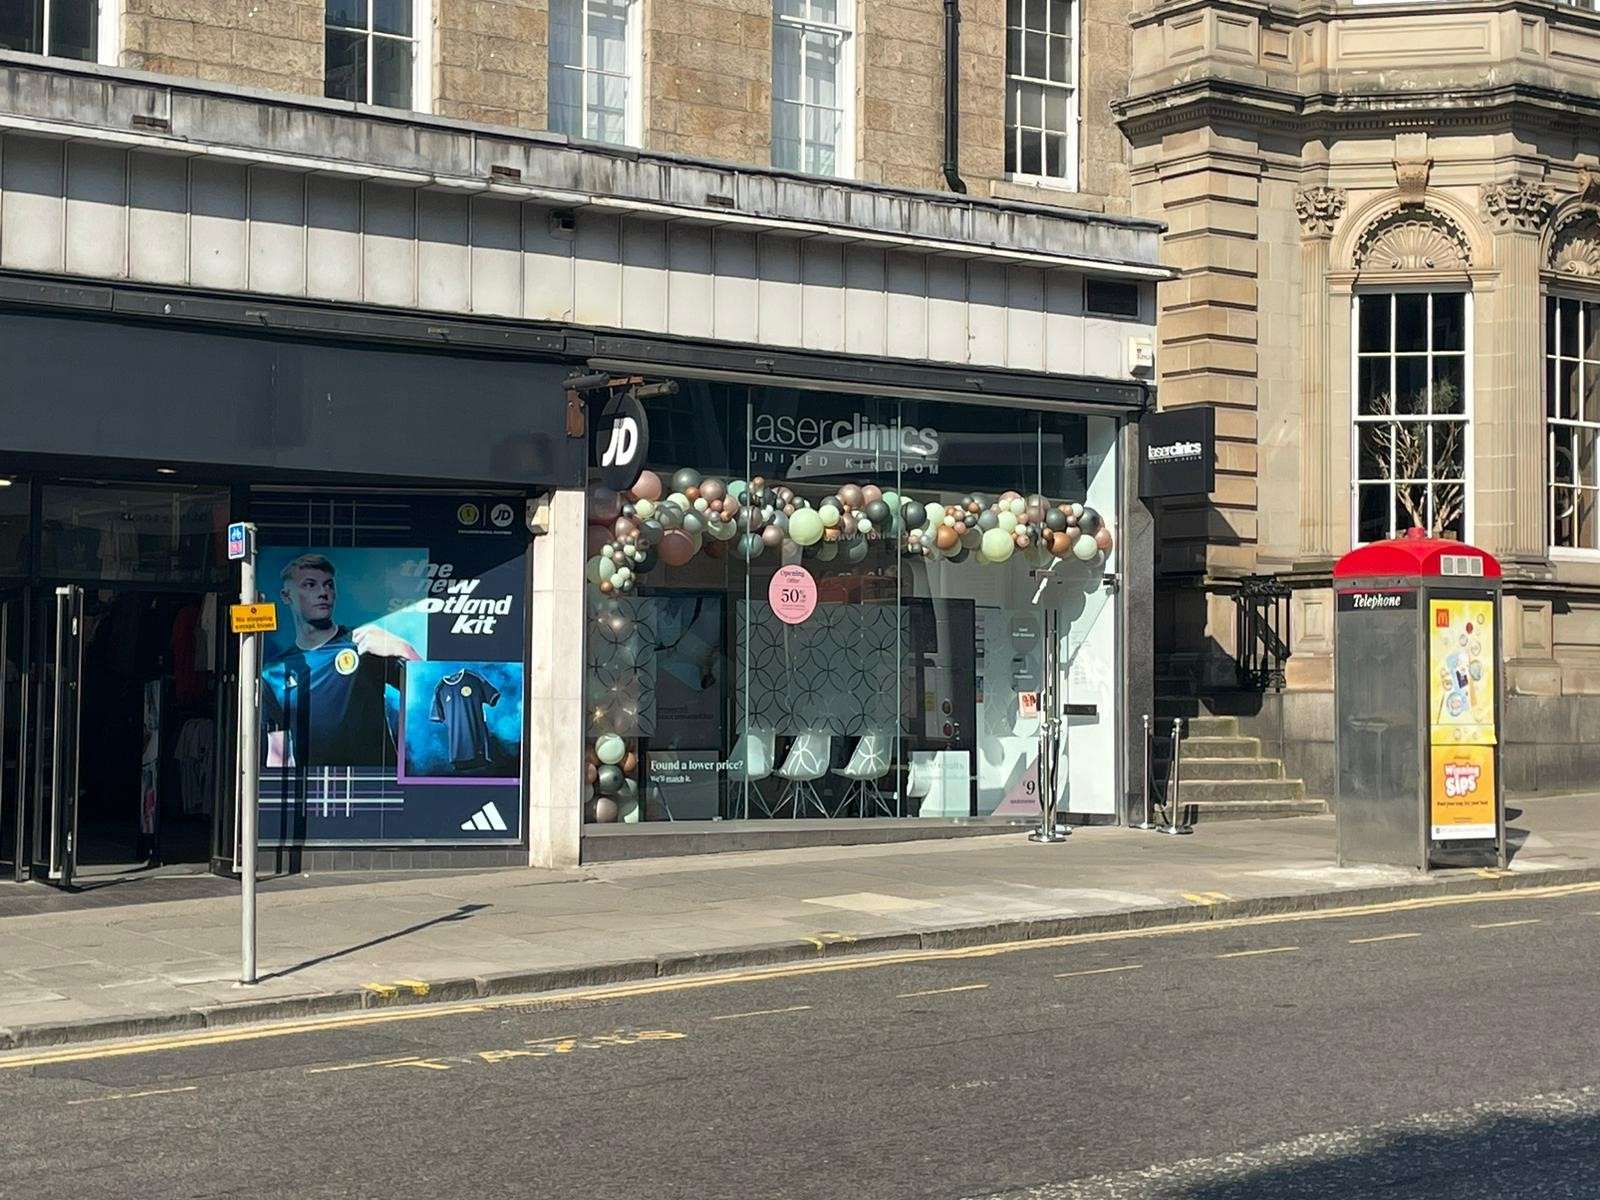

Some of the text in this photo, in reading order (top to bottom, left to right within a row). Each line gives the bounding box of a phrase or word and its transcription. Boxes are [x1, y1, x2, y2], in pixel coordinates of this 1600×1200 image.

[602, 417, 638, 466] JD
[750, 413, 939, 455] laserclinics
[751, 451, 939, 475] UNITED KINGDOM
[400, 560, 453, 578] the
[414, 579, 480, 594] new
[1353, 594, 1401, 610] Telephone
[451, 615, 497, 634] kit
[651, 760, 743, 772] Found a lower price?
